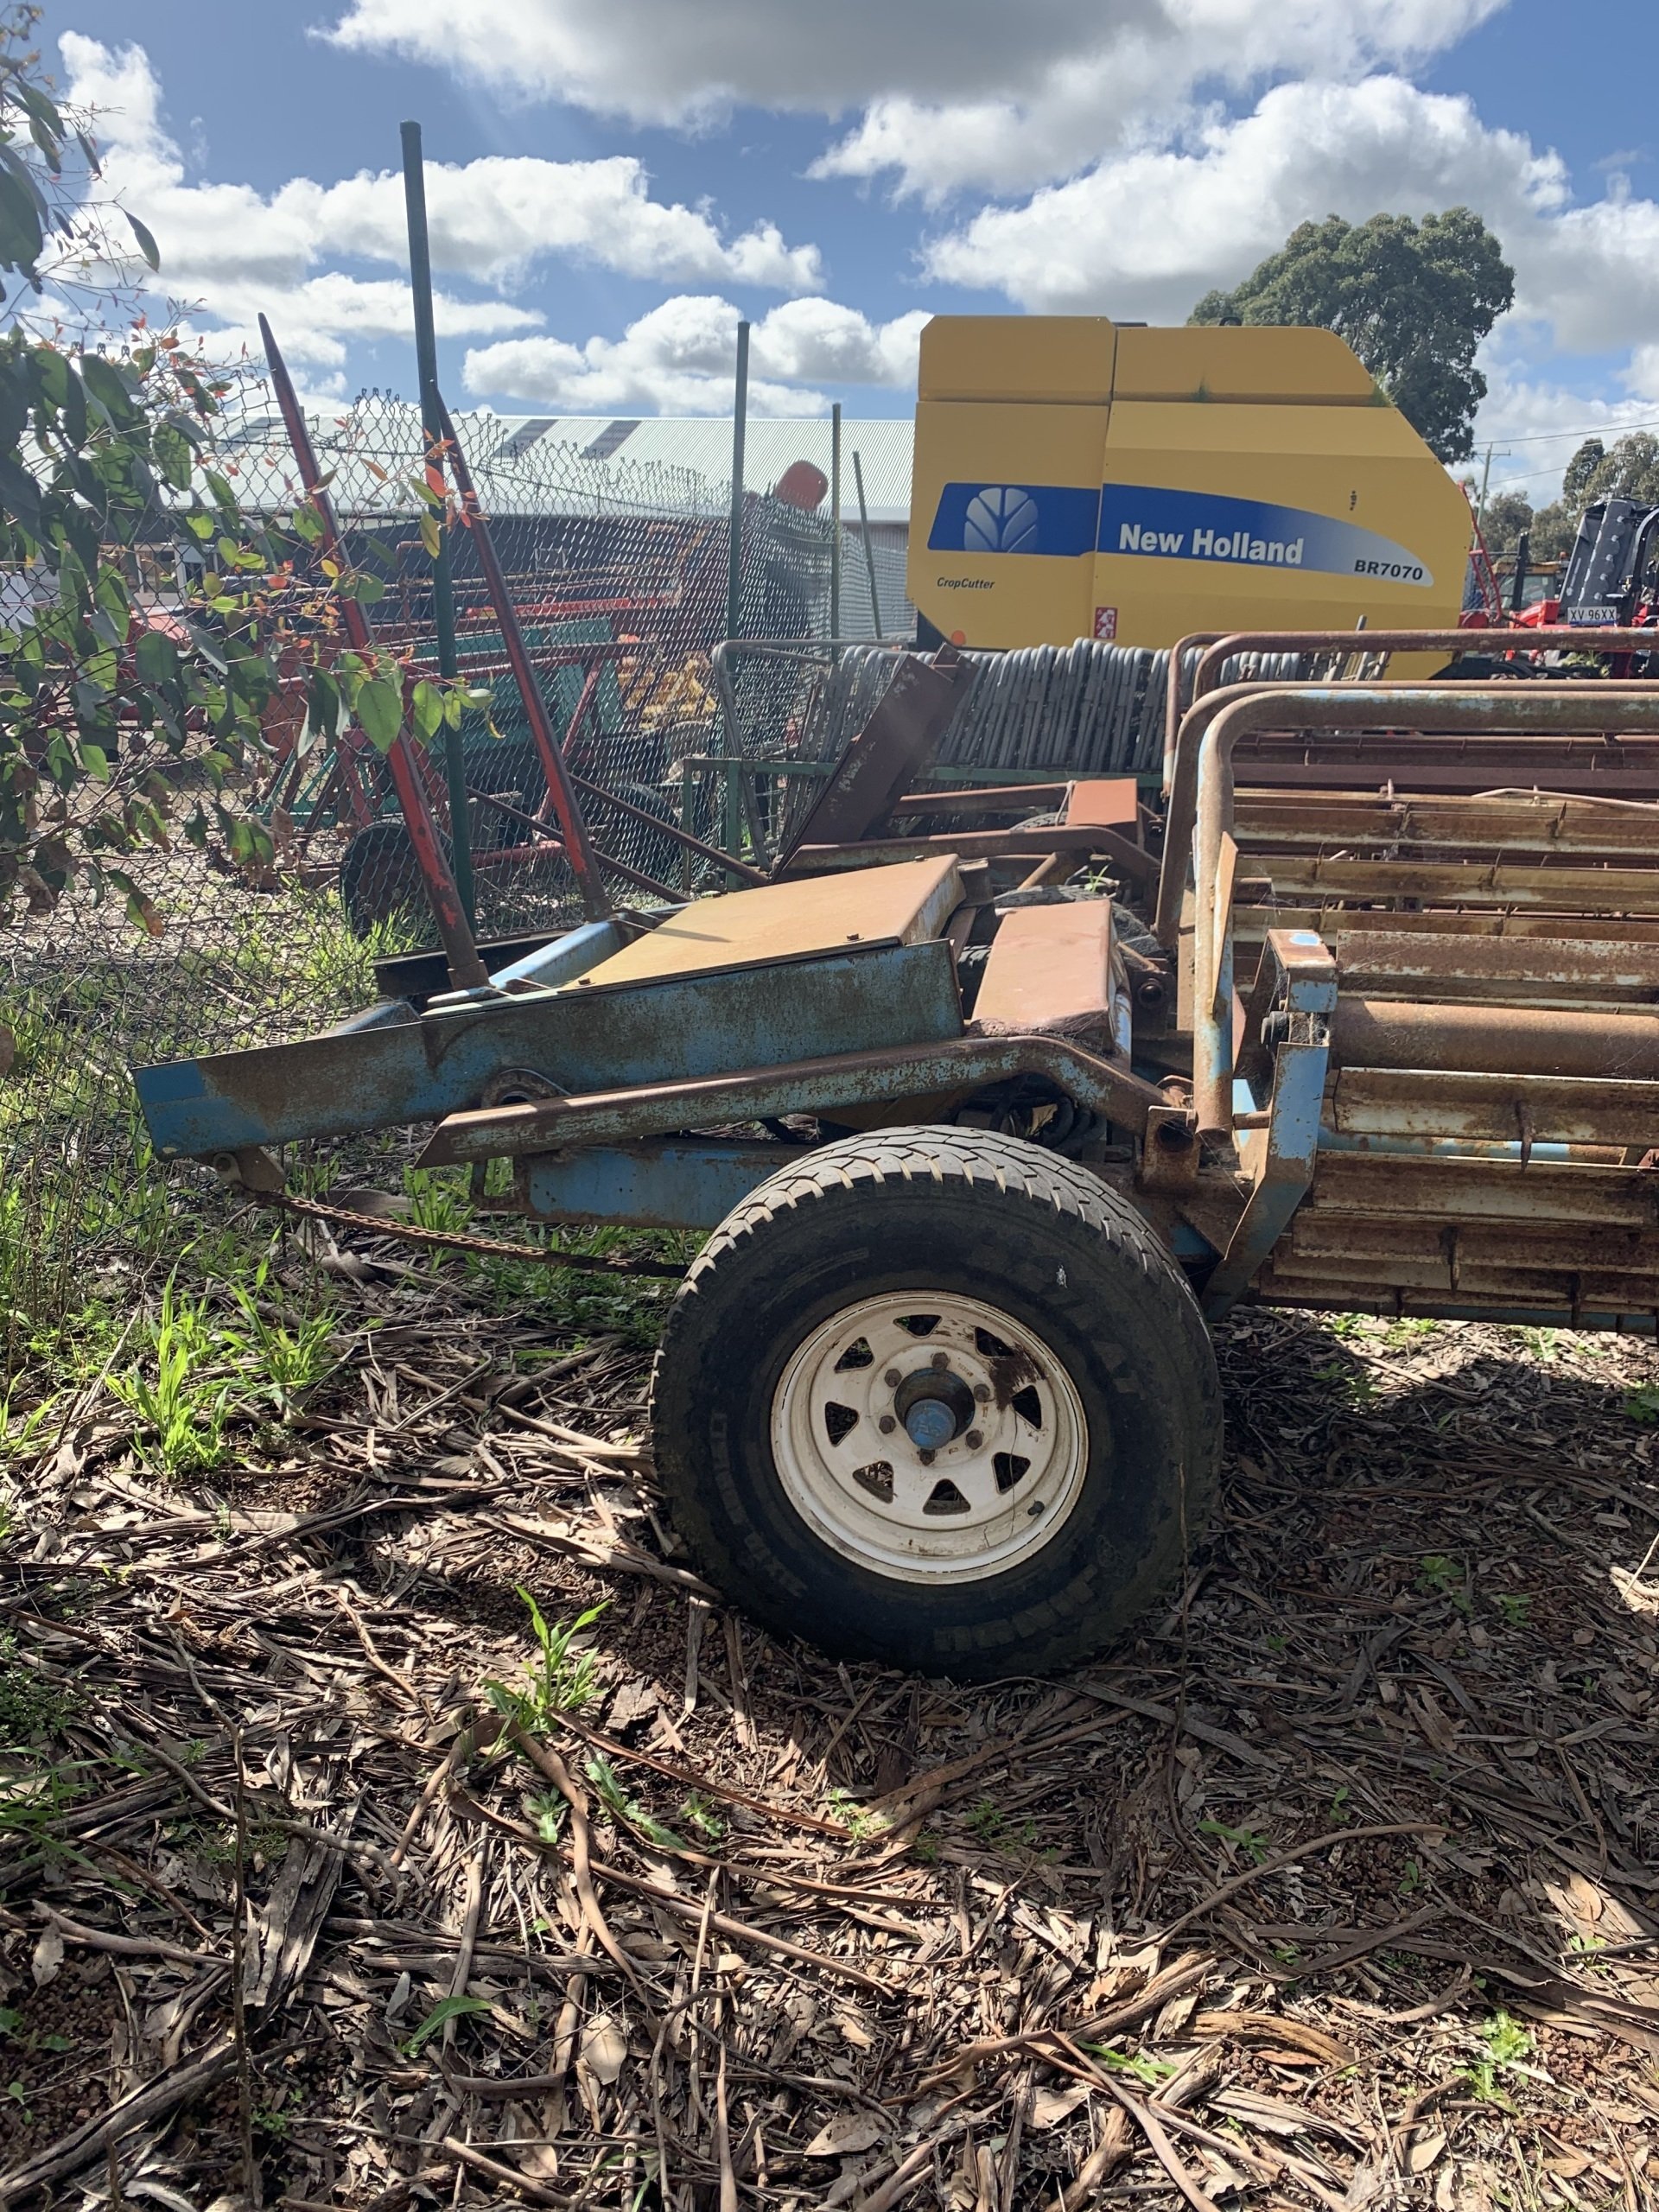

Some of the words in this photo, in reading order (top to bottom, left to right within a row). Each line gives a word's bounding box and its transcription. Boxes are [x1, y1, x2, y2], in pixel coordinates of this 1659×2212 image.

[1119, 524, 1185, 554] New
[1191, 528, 1305, 565] Holland
[1354, 559, 1424, 581] BR7070
[937, 576, 995, 590] CropCutter
